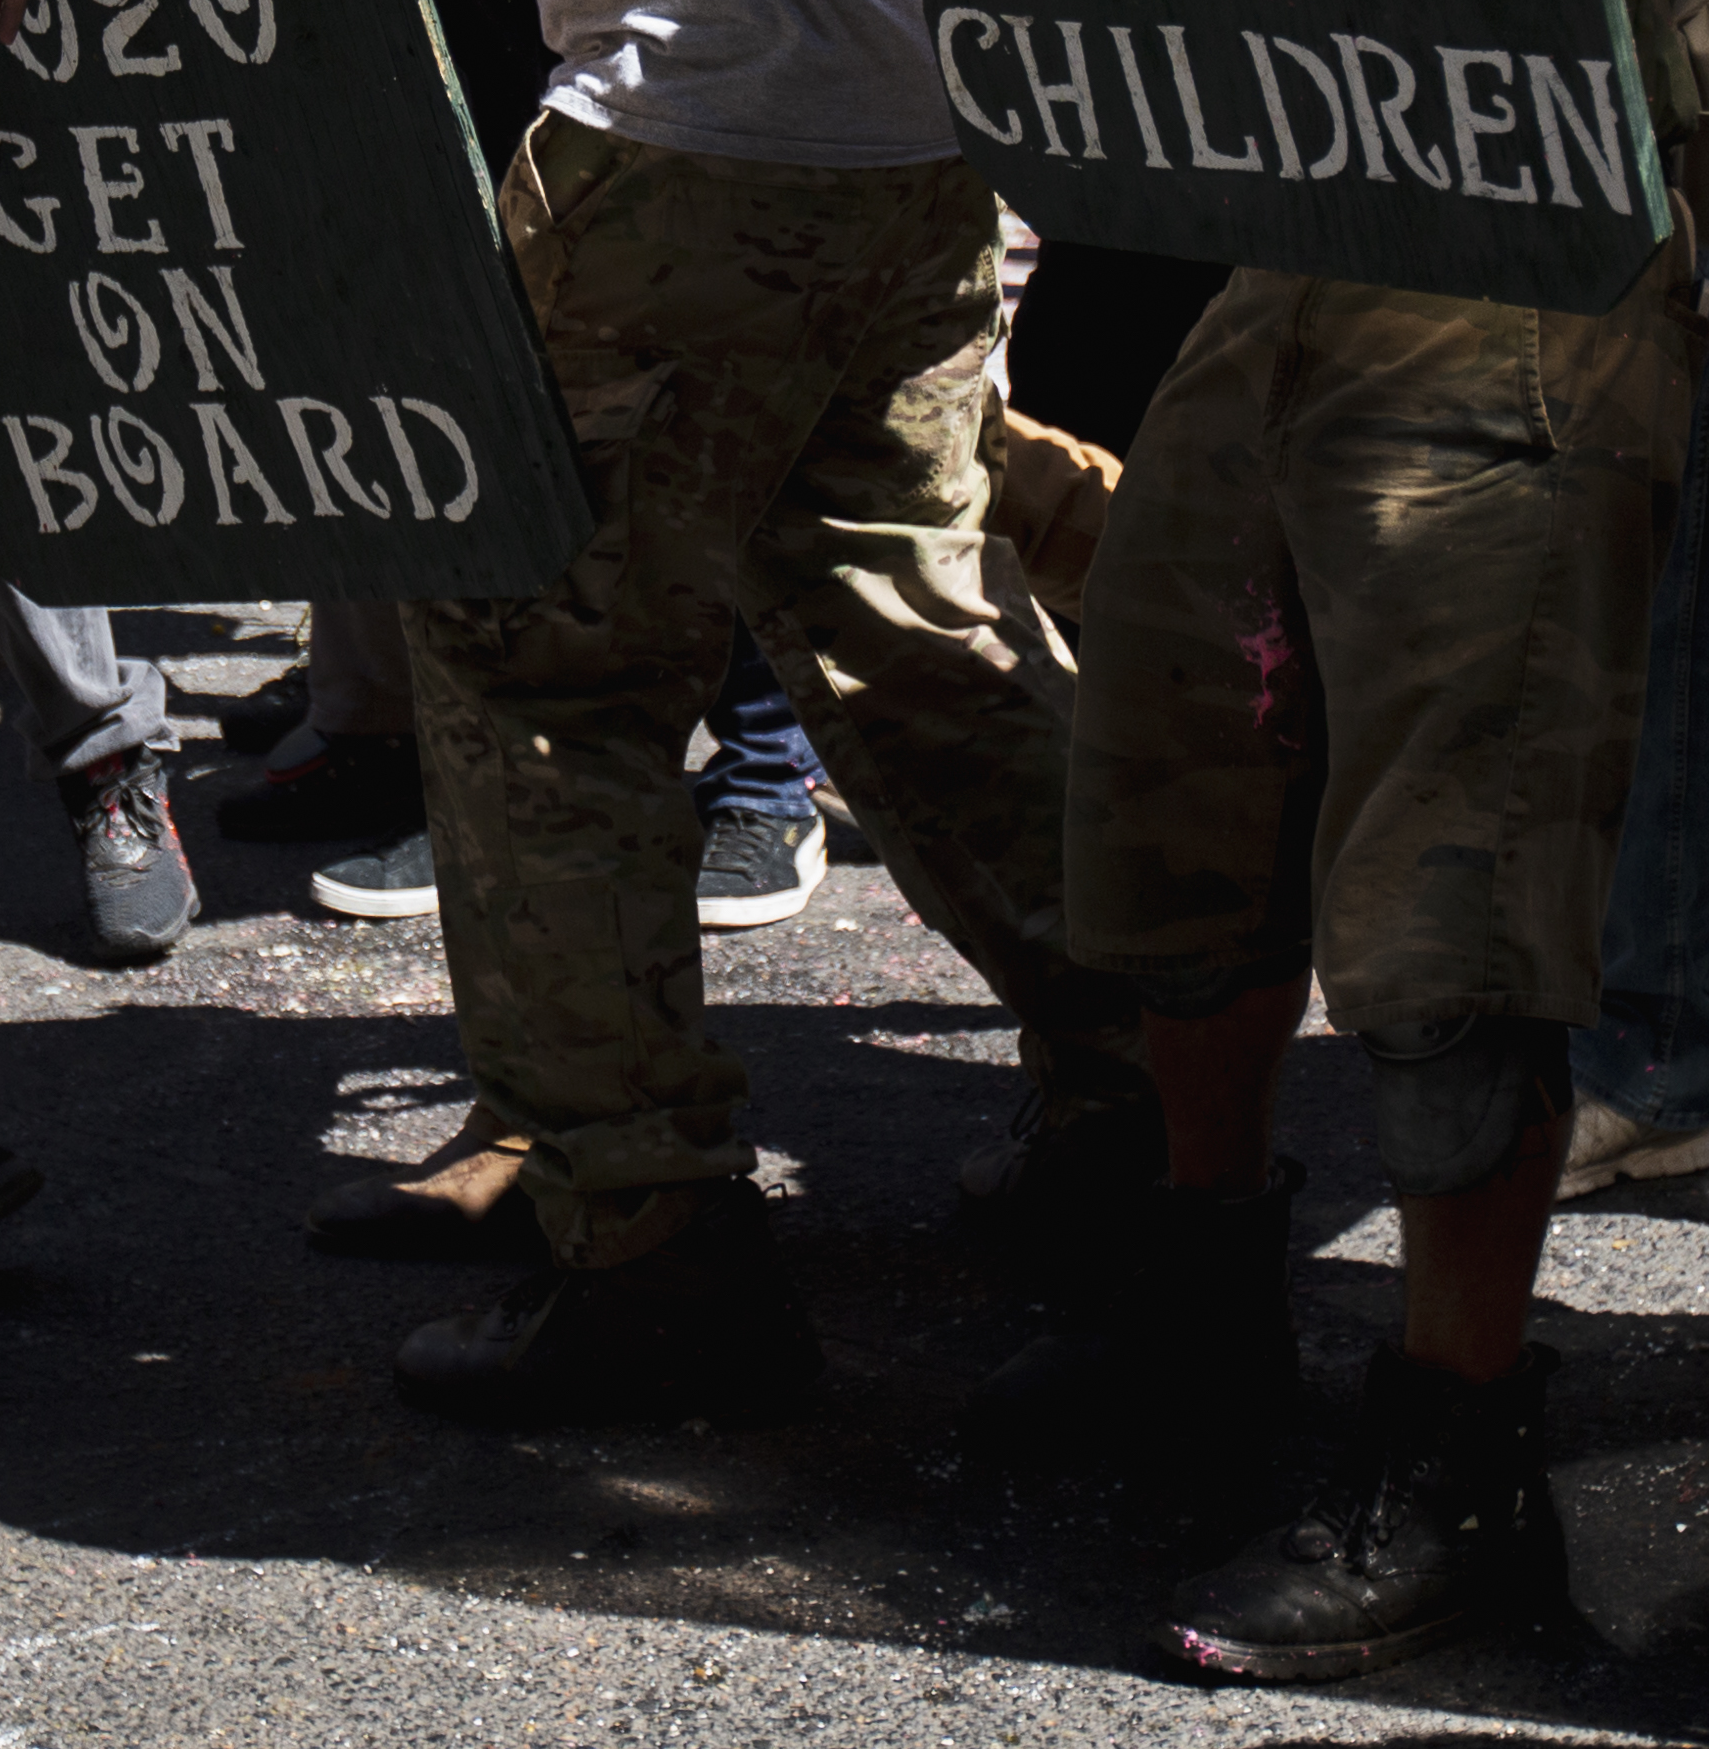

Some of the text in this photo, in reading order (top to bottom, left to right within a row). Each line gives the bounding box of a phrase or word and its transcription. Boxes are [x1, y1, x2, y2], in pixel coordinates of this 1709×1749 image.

[938, 6, 1633, 216] CHILDREN
[69, 265, 266, 393] ON
[2, 395, 480, 535] BOARD
